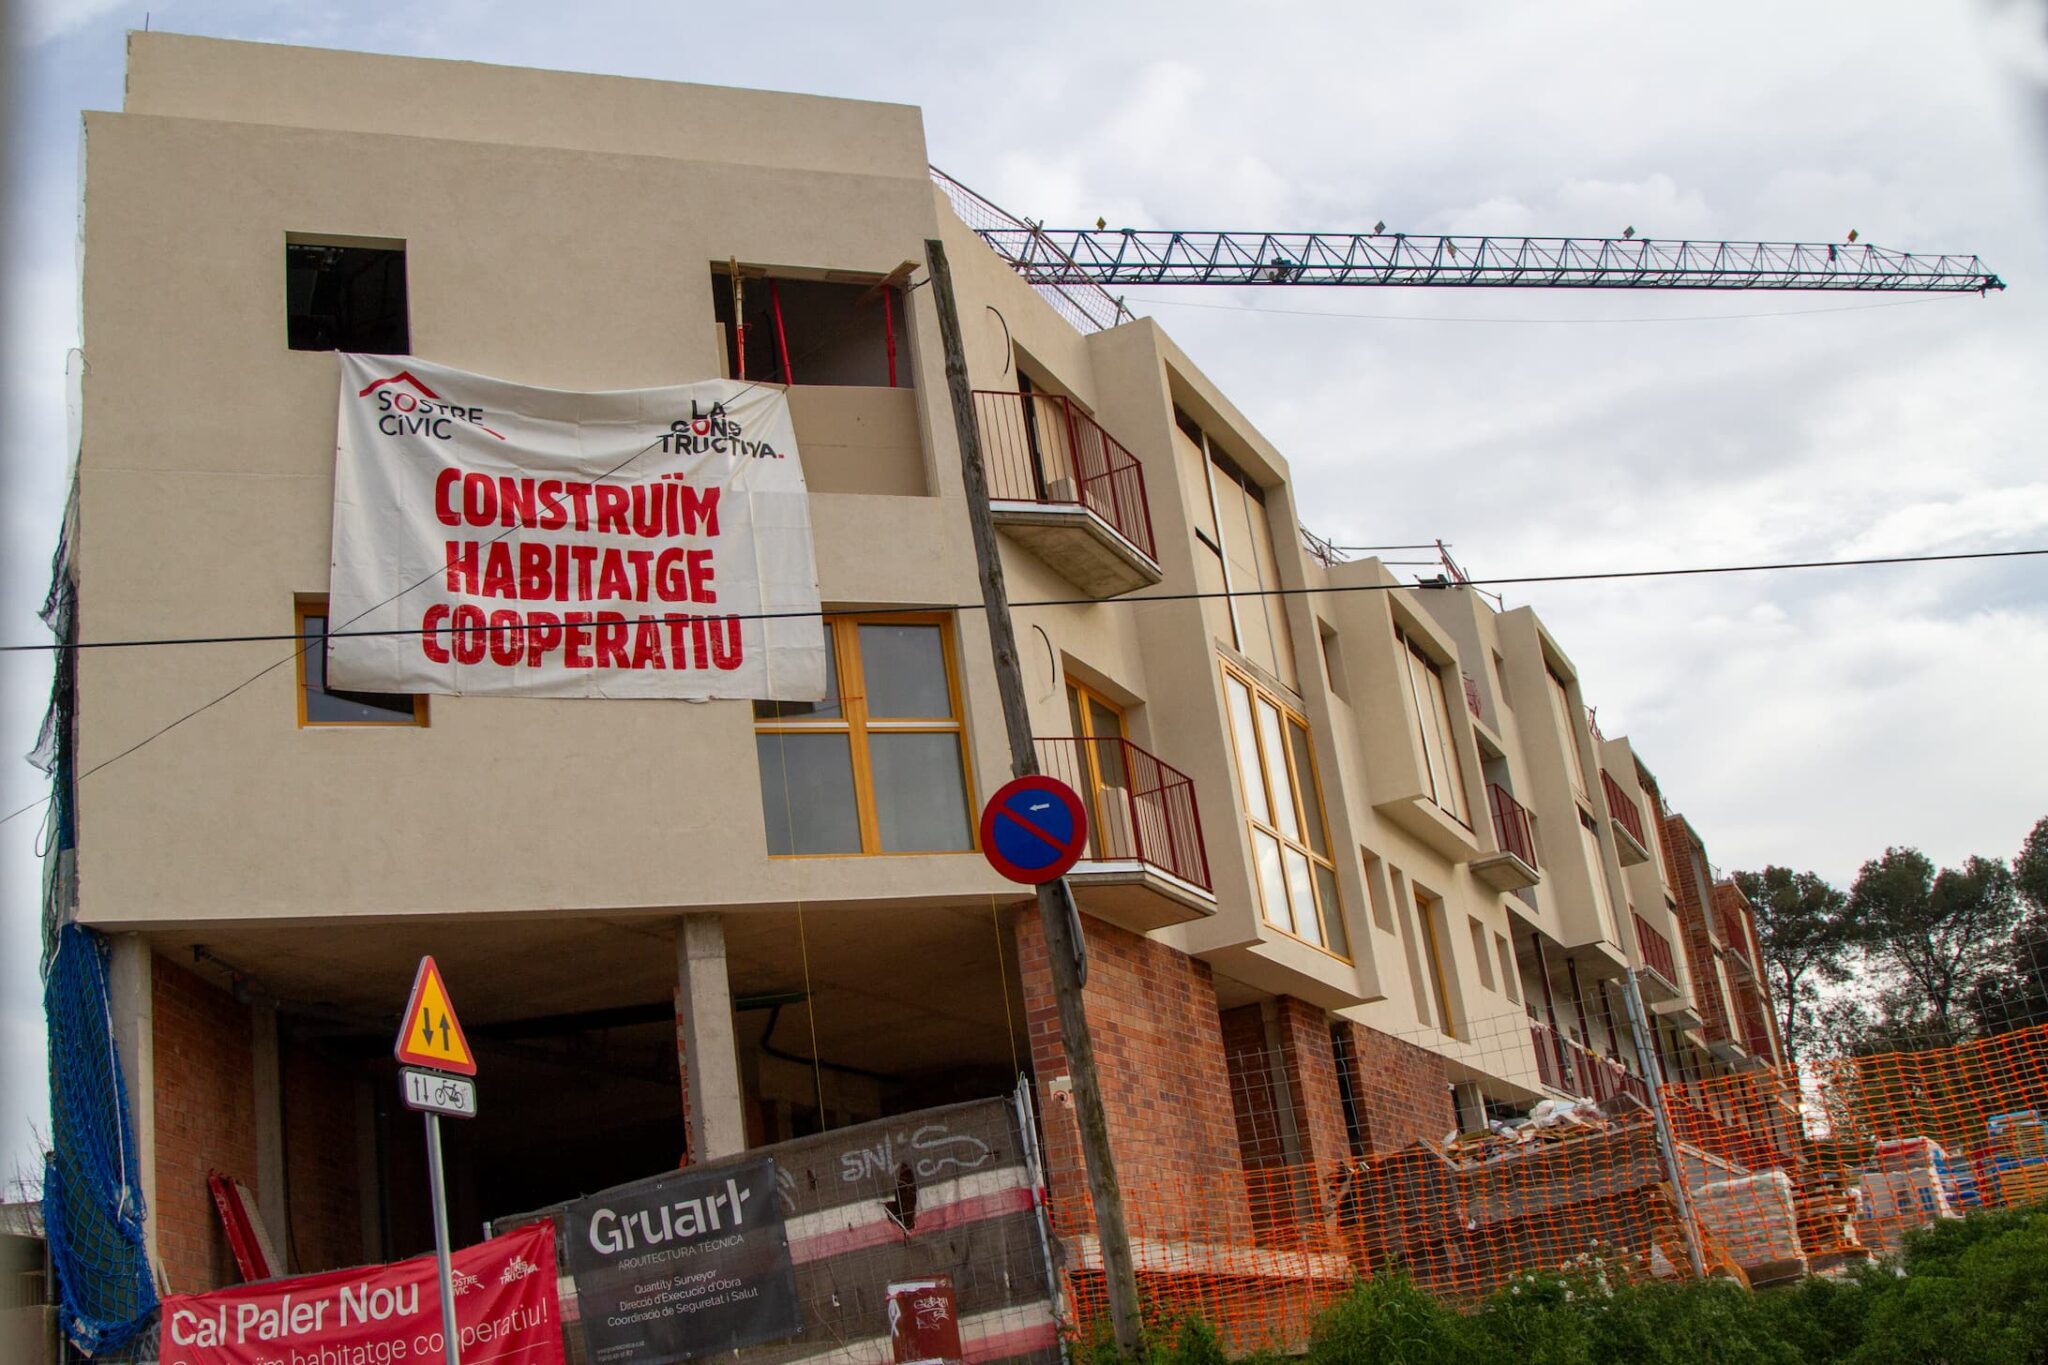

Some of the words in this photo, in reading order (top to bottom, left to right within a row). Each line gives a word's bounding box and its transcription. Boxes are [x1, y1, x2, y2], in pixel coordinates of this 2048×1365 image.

[378, 390, 484, 427] SOSTRE
[671, 417, 742, 438] CONS
[691, 399, 727, 420] LA
[435, 467, 721, 538] CONSTRUÏM
[445, 540, 717, 604] HABITATGE
[422, 603, 744, 670] COOPERATIU
[589, 1178, 750, 1255] Gruart
[618, 1246, 697, 1271] ARQUITECTURA
[452, 1274, 479, 1288] OSTRE
[619, 1295, 652, 1312] Direcció
[707, 1277, 742, 1293] d'Obra
[634, 1279, 672, 1295] Quantity
[674, 1269, 718, 1288] Surveyor
[171, 1303, 226, 1348] Cal
[236, 1294, 329, 1344] Paler
[339, 1281, 419, 1328] Nou
[413, 1297, 549, 1356] coperatiu!
[607, 1309, 661, 1328] Coordinació
[662, 1305, 675, 1317] de
[675, 1294, 725, 1315] Seguretat
[731, 1286, 759, 1302] Salut
